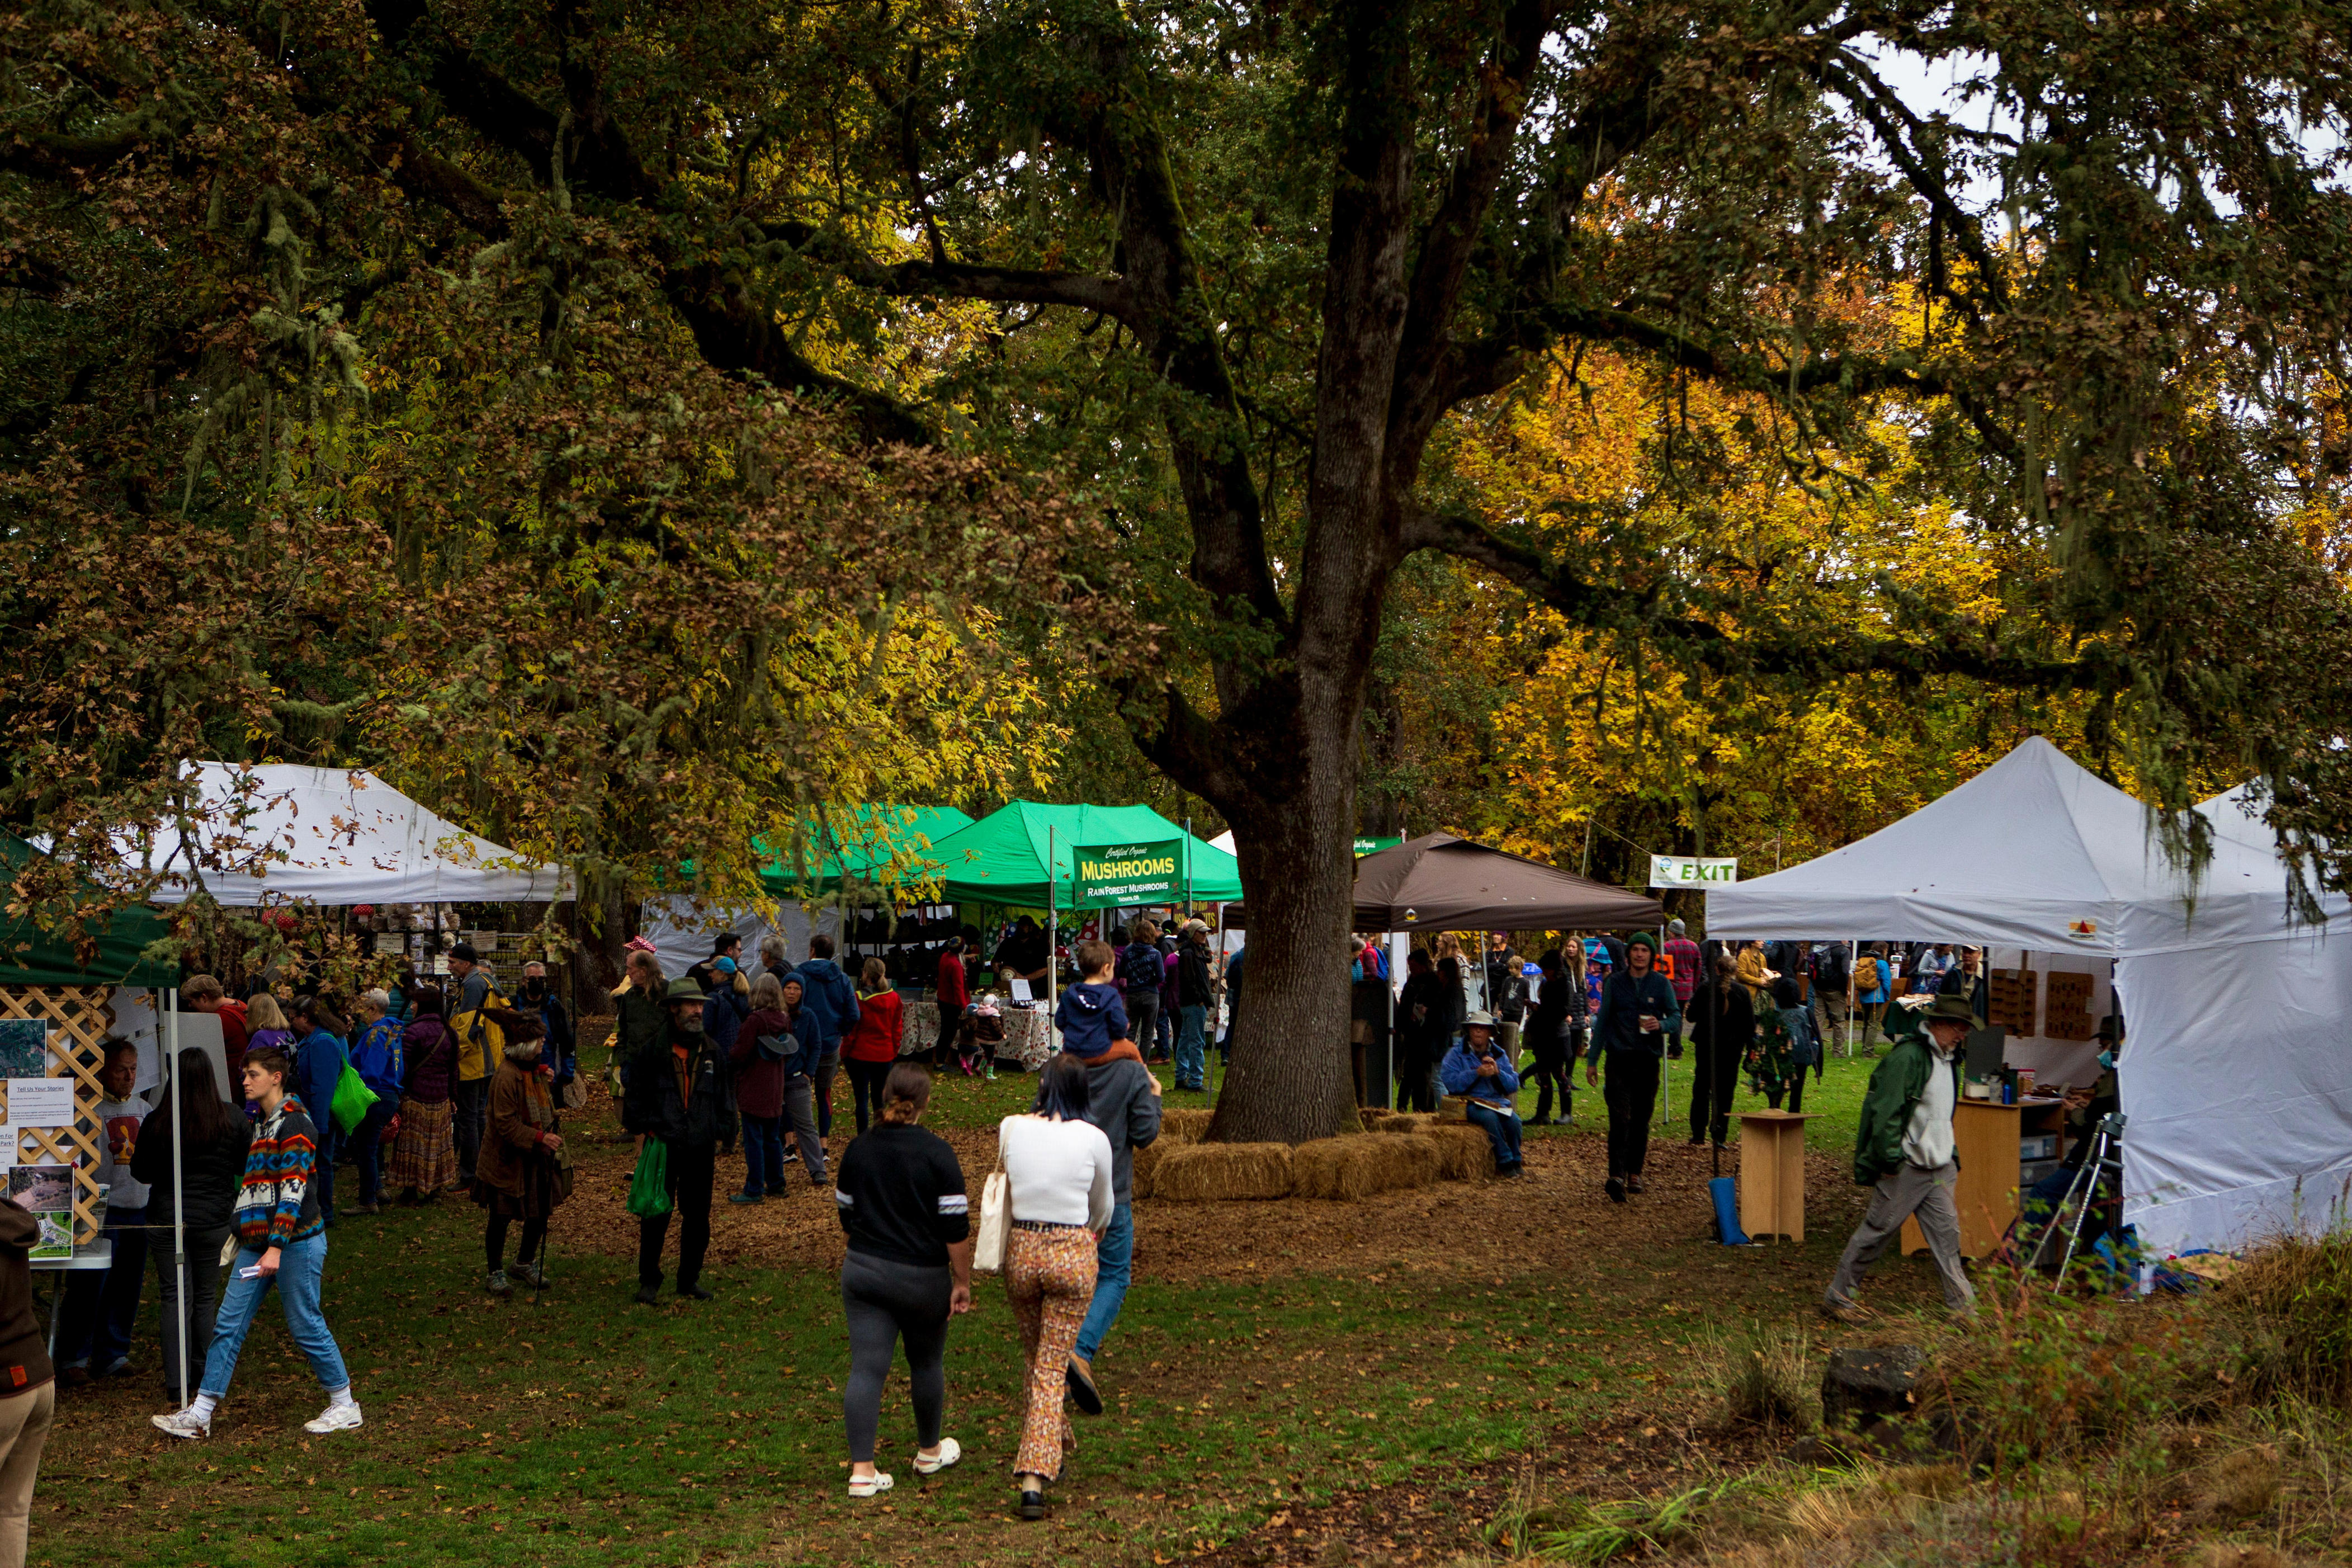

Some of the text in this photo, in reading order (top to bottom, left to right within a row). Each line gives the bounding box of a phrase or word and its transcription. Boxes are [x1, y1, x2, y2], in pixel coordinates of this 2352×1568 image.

[1105, 846, 1147, 859] Certified Organic
[1081, 857, 1175, 881] MUSHROOMS
[1681, 864, 1734, 881] EXIT
[1128, 882, 1169, 893] MUSHROOMS
